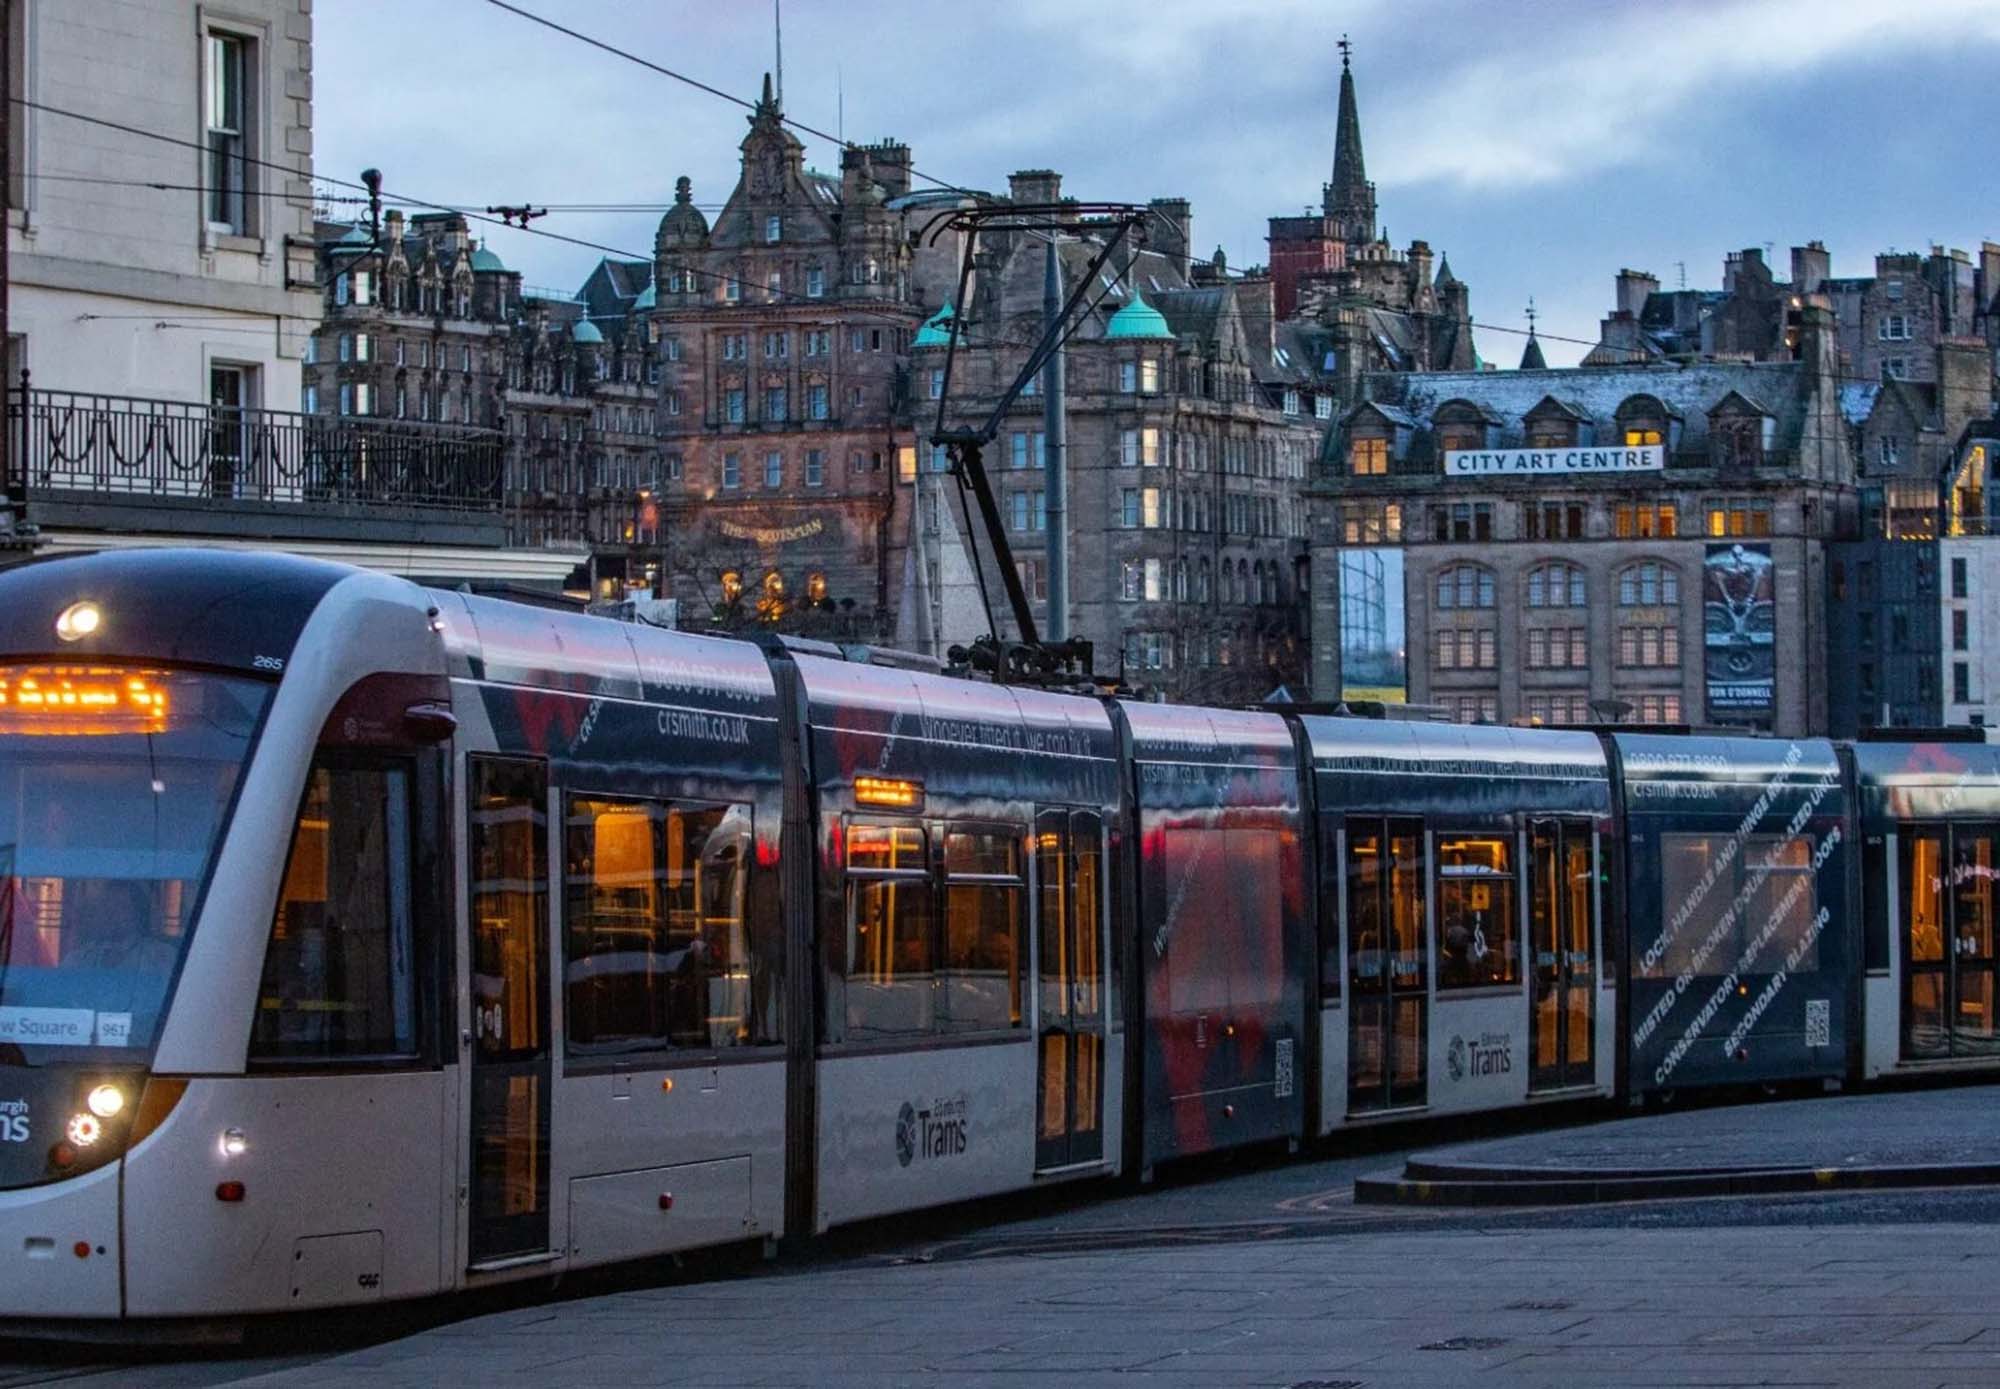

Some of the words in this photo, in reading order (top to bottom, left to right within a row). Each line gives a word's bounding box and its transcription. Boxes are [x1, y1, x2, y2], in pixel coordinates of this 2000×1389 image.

[1457, 454, 1507, 471] CITY
[1515, 453, 1558, 469] ART
[1566, 450, 1652, 468] CENTRE
[253, 655, 283, 670] 265
[1672, 869, 1715, 934] HANDLE
[1715, 839, 1737, 876] AND
[1736, 793, 1769, 844] HINGE
[1633, 989, 1676, 1048] MISTED
[1675, 965, 1694, 994] OR
[1692, 908, 1736, 973] BROKEN
[1655, 967, 1739, 1084] CONSERVATORY
[1737, 874, 1808, 974] REPLACEMENT
[1724, 962, 1787, 1057] SECONDARY
[1785, 906, 1830, 970] GLAZING
[19, 1018, 78, 1037] Square
[1468, 1041, 1511, 1077] Trams
[918, 1110, 967, 1159] Trams
